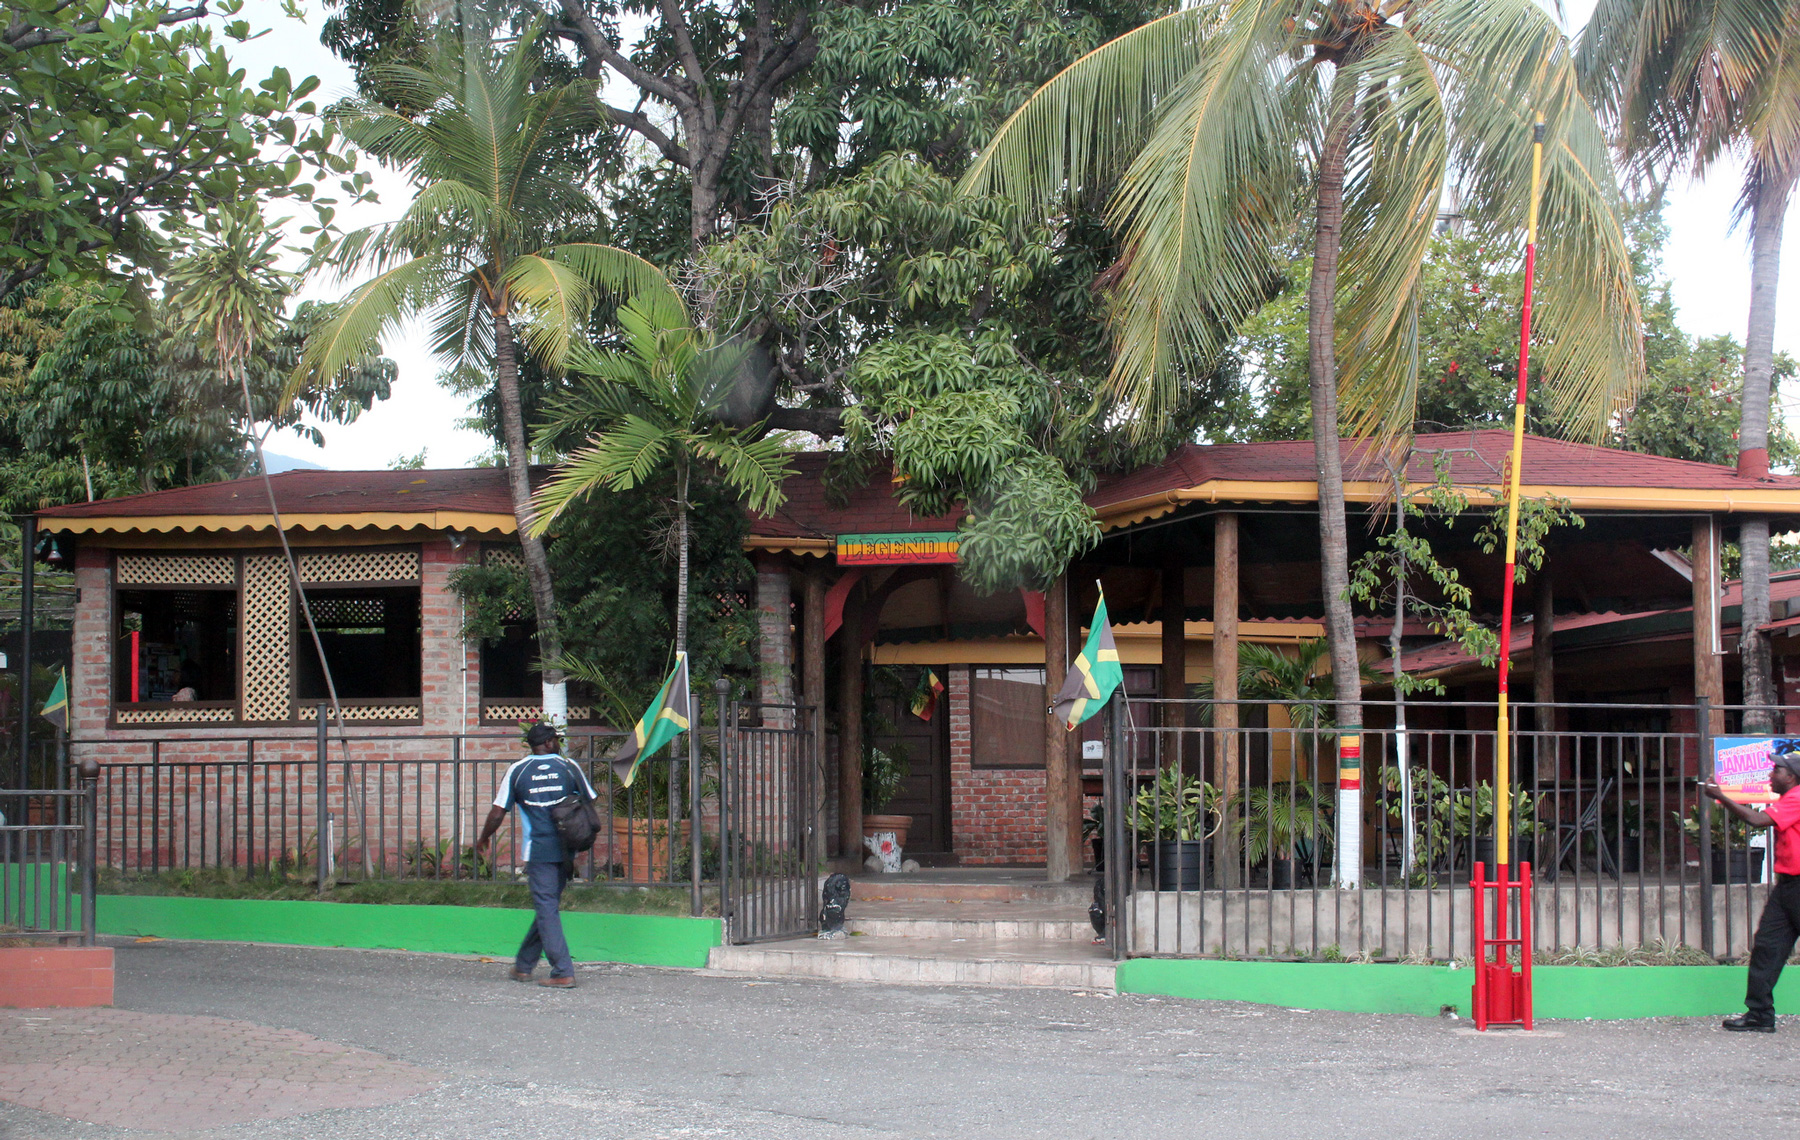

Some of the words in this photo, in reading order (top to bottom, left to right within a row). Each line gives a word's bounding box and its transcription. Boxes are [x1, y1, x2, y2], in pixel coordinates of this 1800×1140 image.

[1502, 455, 1513, 500] STOP
[845, 536, 940, 561] LEGEND
[1717, 740, 1773, 761] EXPERIENCE
[1719, 750, 1775, 774] JAMAICA
[1740, 784, 1764, 793] JAMAICA
